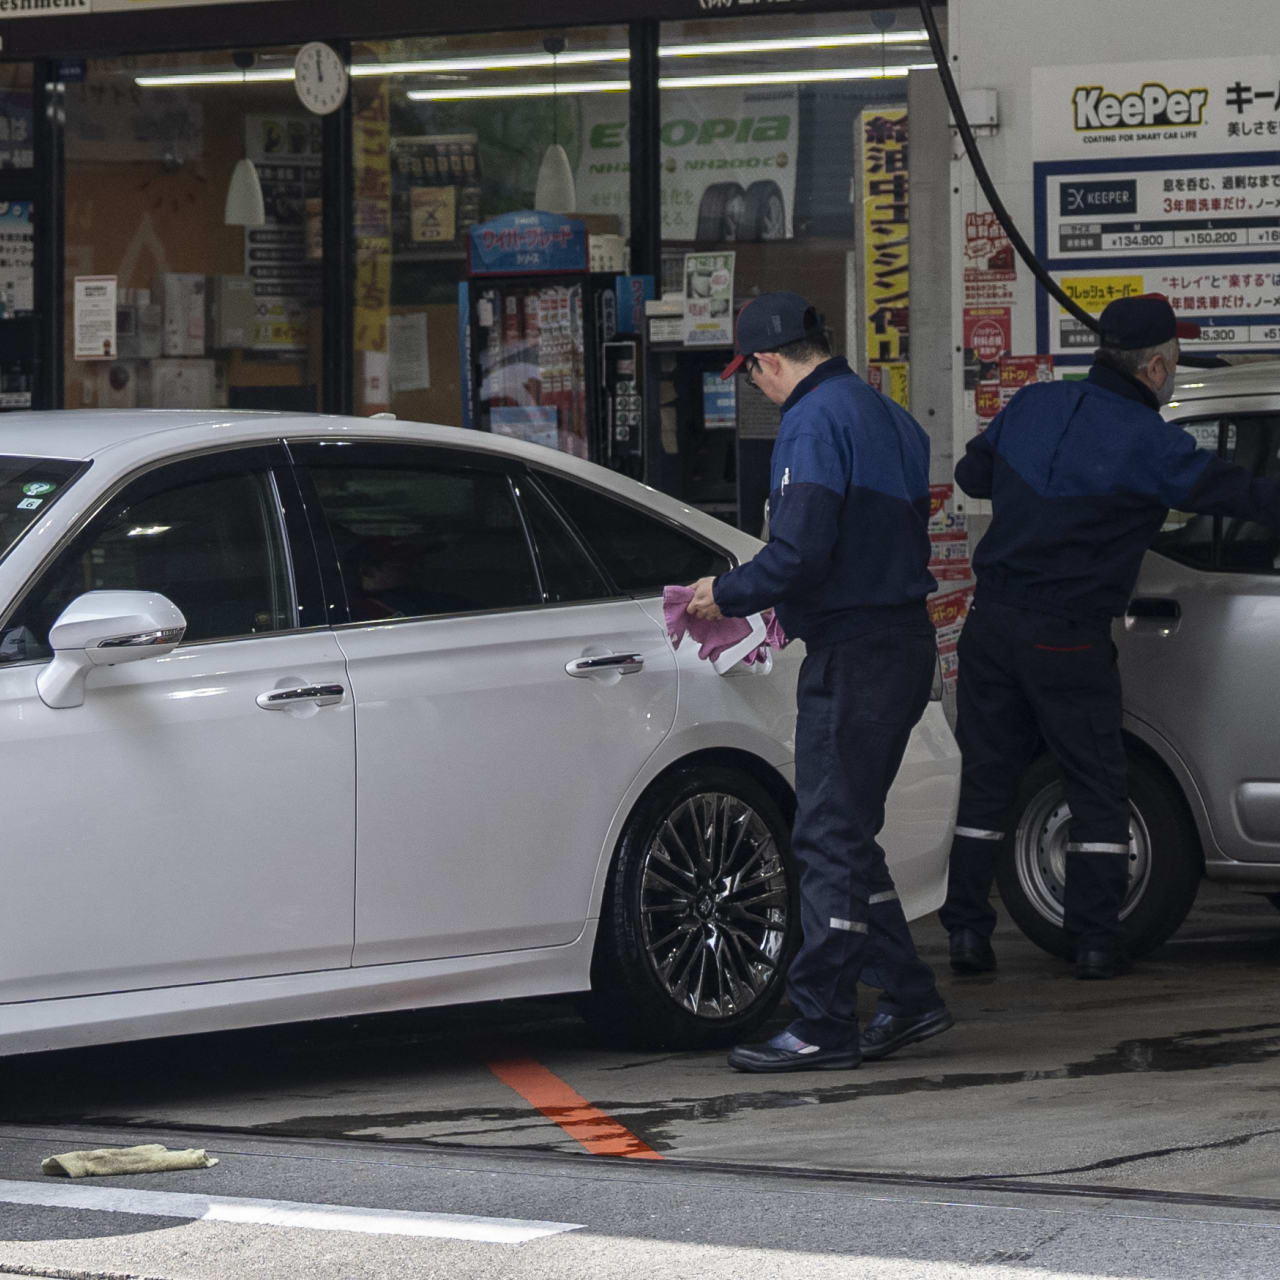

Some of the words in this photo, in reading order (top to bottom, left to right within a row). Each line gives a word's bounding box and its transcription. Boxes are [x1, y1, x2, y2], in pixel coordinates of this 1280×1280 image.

[1072, 82, 1209, 131] KeePer
[1083, 134, 1116, 144] COATING
[1119, 133, 1133, 142] FOR
[1136, 132, 1161, 142] SMART
[1163, 131, 1178, 140] CAR
[1180, 130, 1197, 139] LIFE
